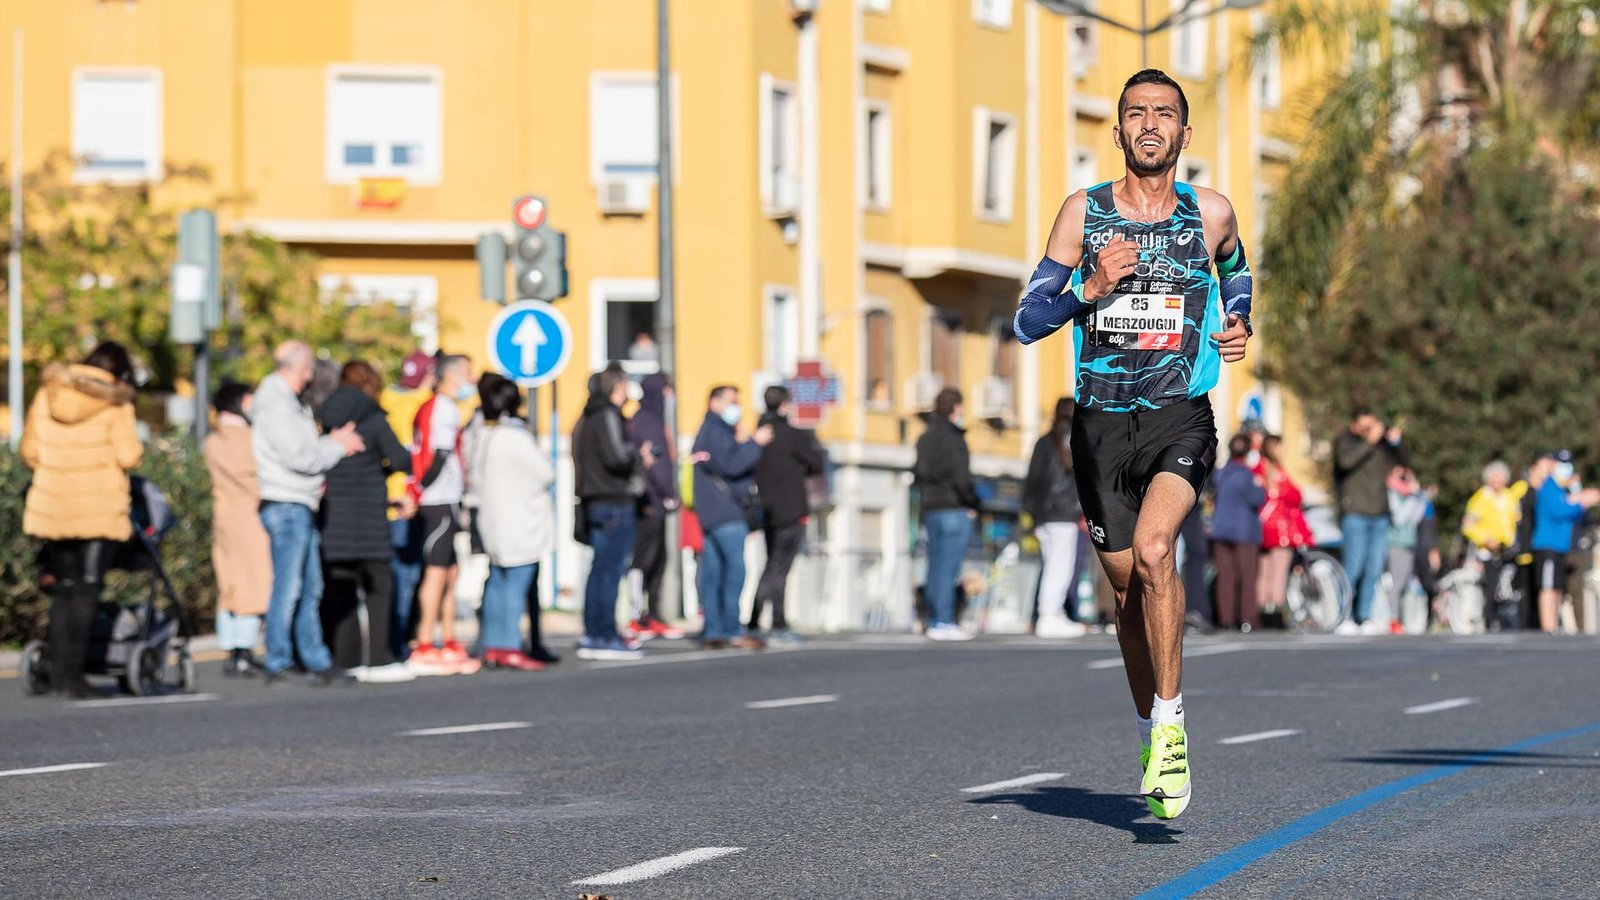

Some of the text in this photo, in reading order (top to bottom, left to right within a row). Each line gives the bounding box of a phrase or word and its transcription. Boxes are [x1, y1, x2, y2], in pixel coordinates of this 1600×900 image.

[1134, 231, 1168, 249] TRIBE
[1131, 297, 1149, 311] 85
[1103, 316, 1176, 331] MERZOUGUI
[1108, 333, 1125, 346] edp
